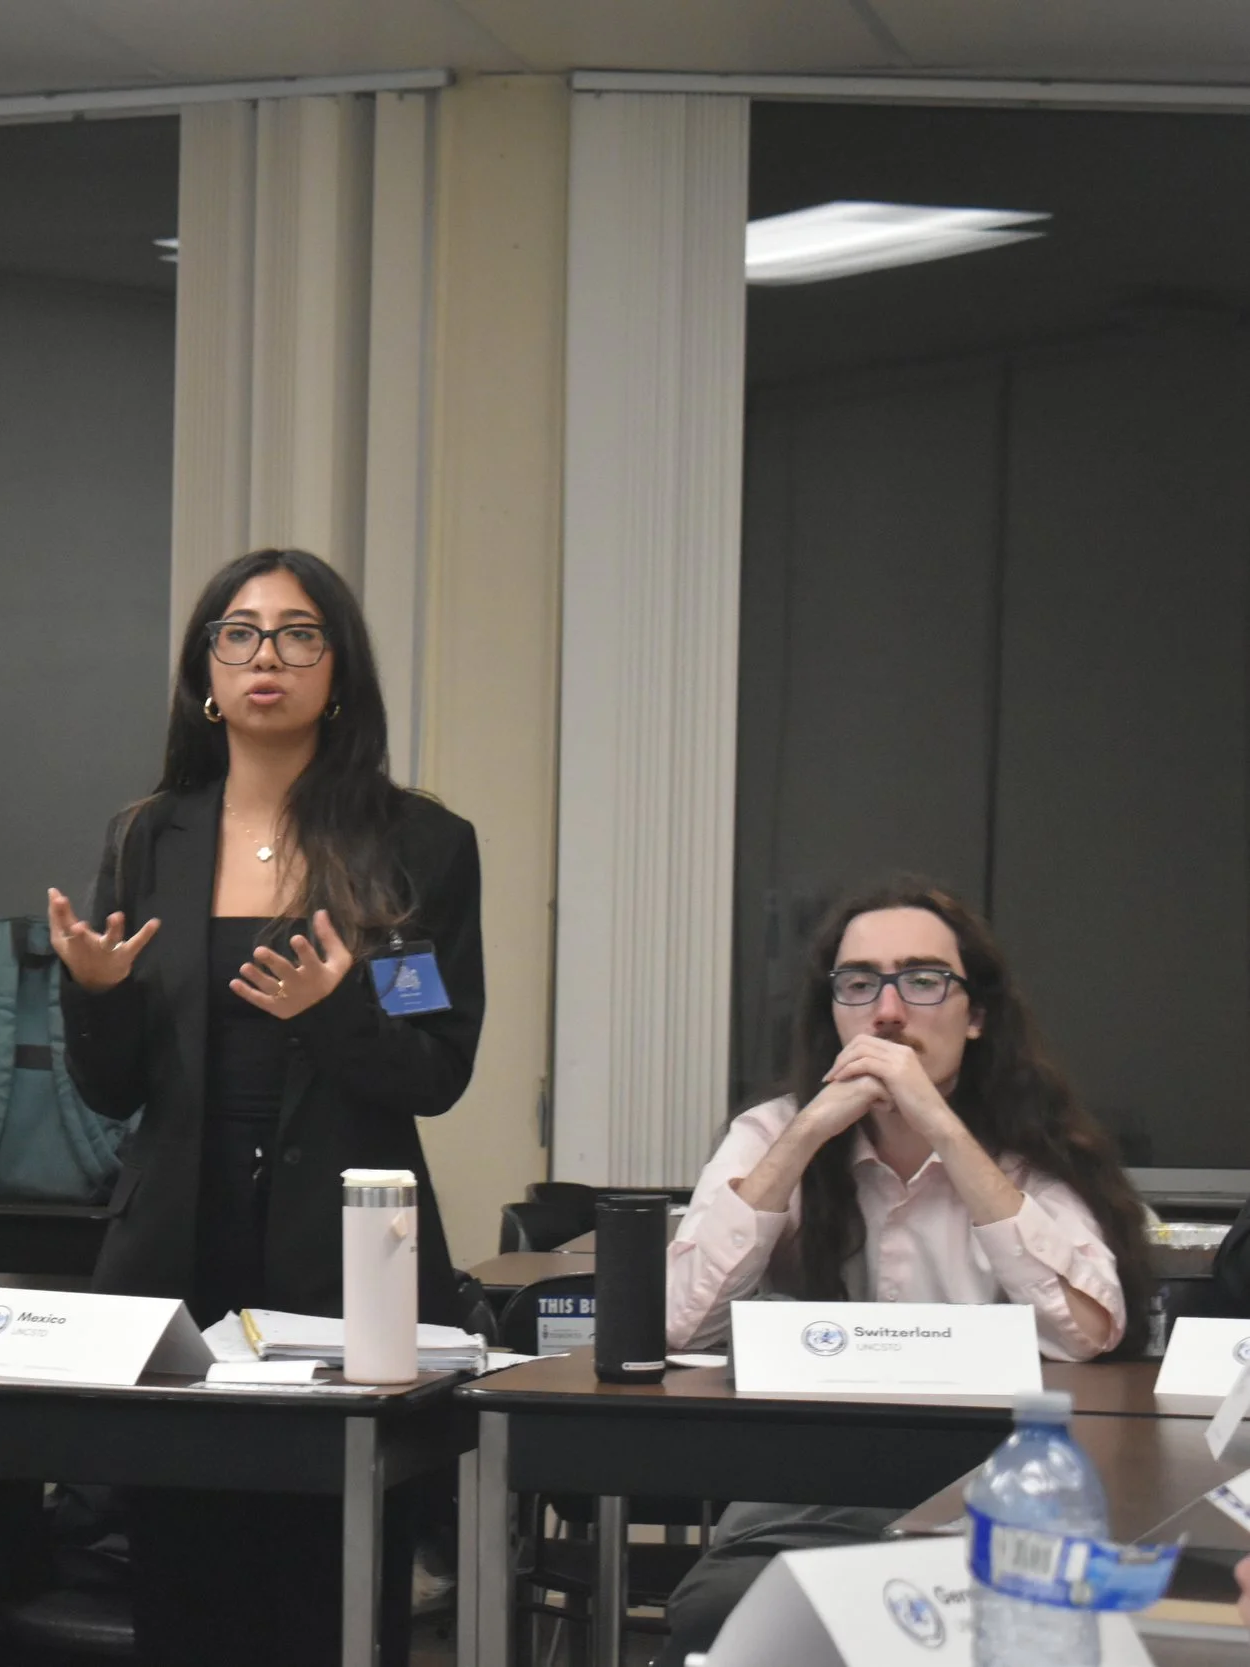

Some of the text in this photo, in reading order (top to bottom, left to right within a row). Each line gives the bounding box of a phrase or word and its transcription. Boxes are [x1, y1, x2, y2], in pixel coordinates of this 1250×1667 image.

[537, 1298, 574, 1314] THIS
[16, 1311, 67, 1325] Mexico
[853, 1326, 952, 1338] Switzerland
